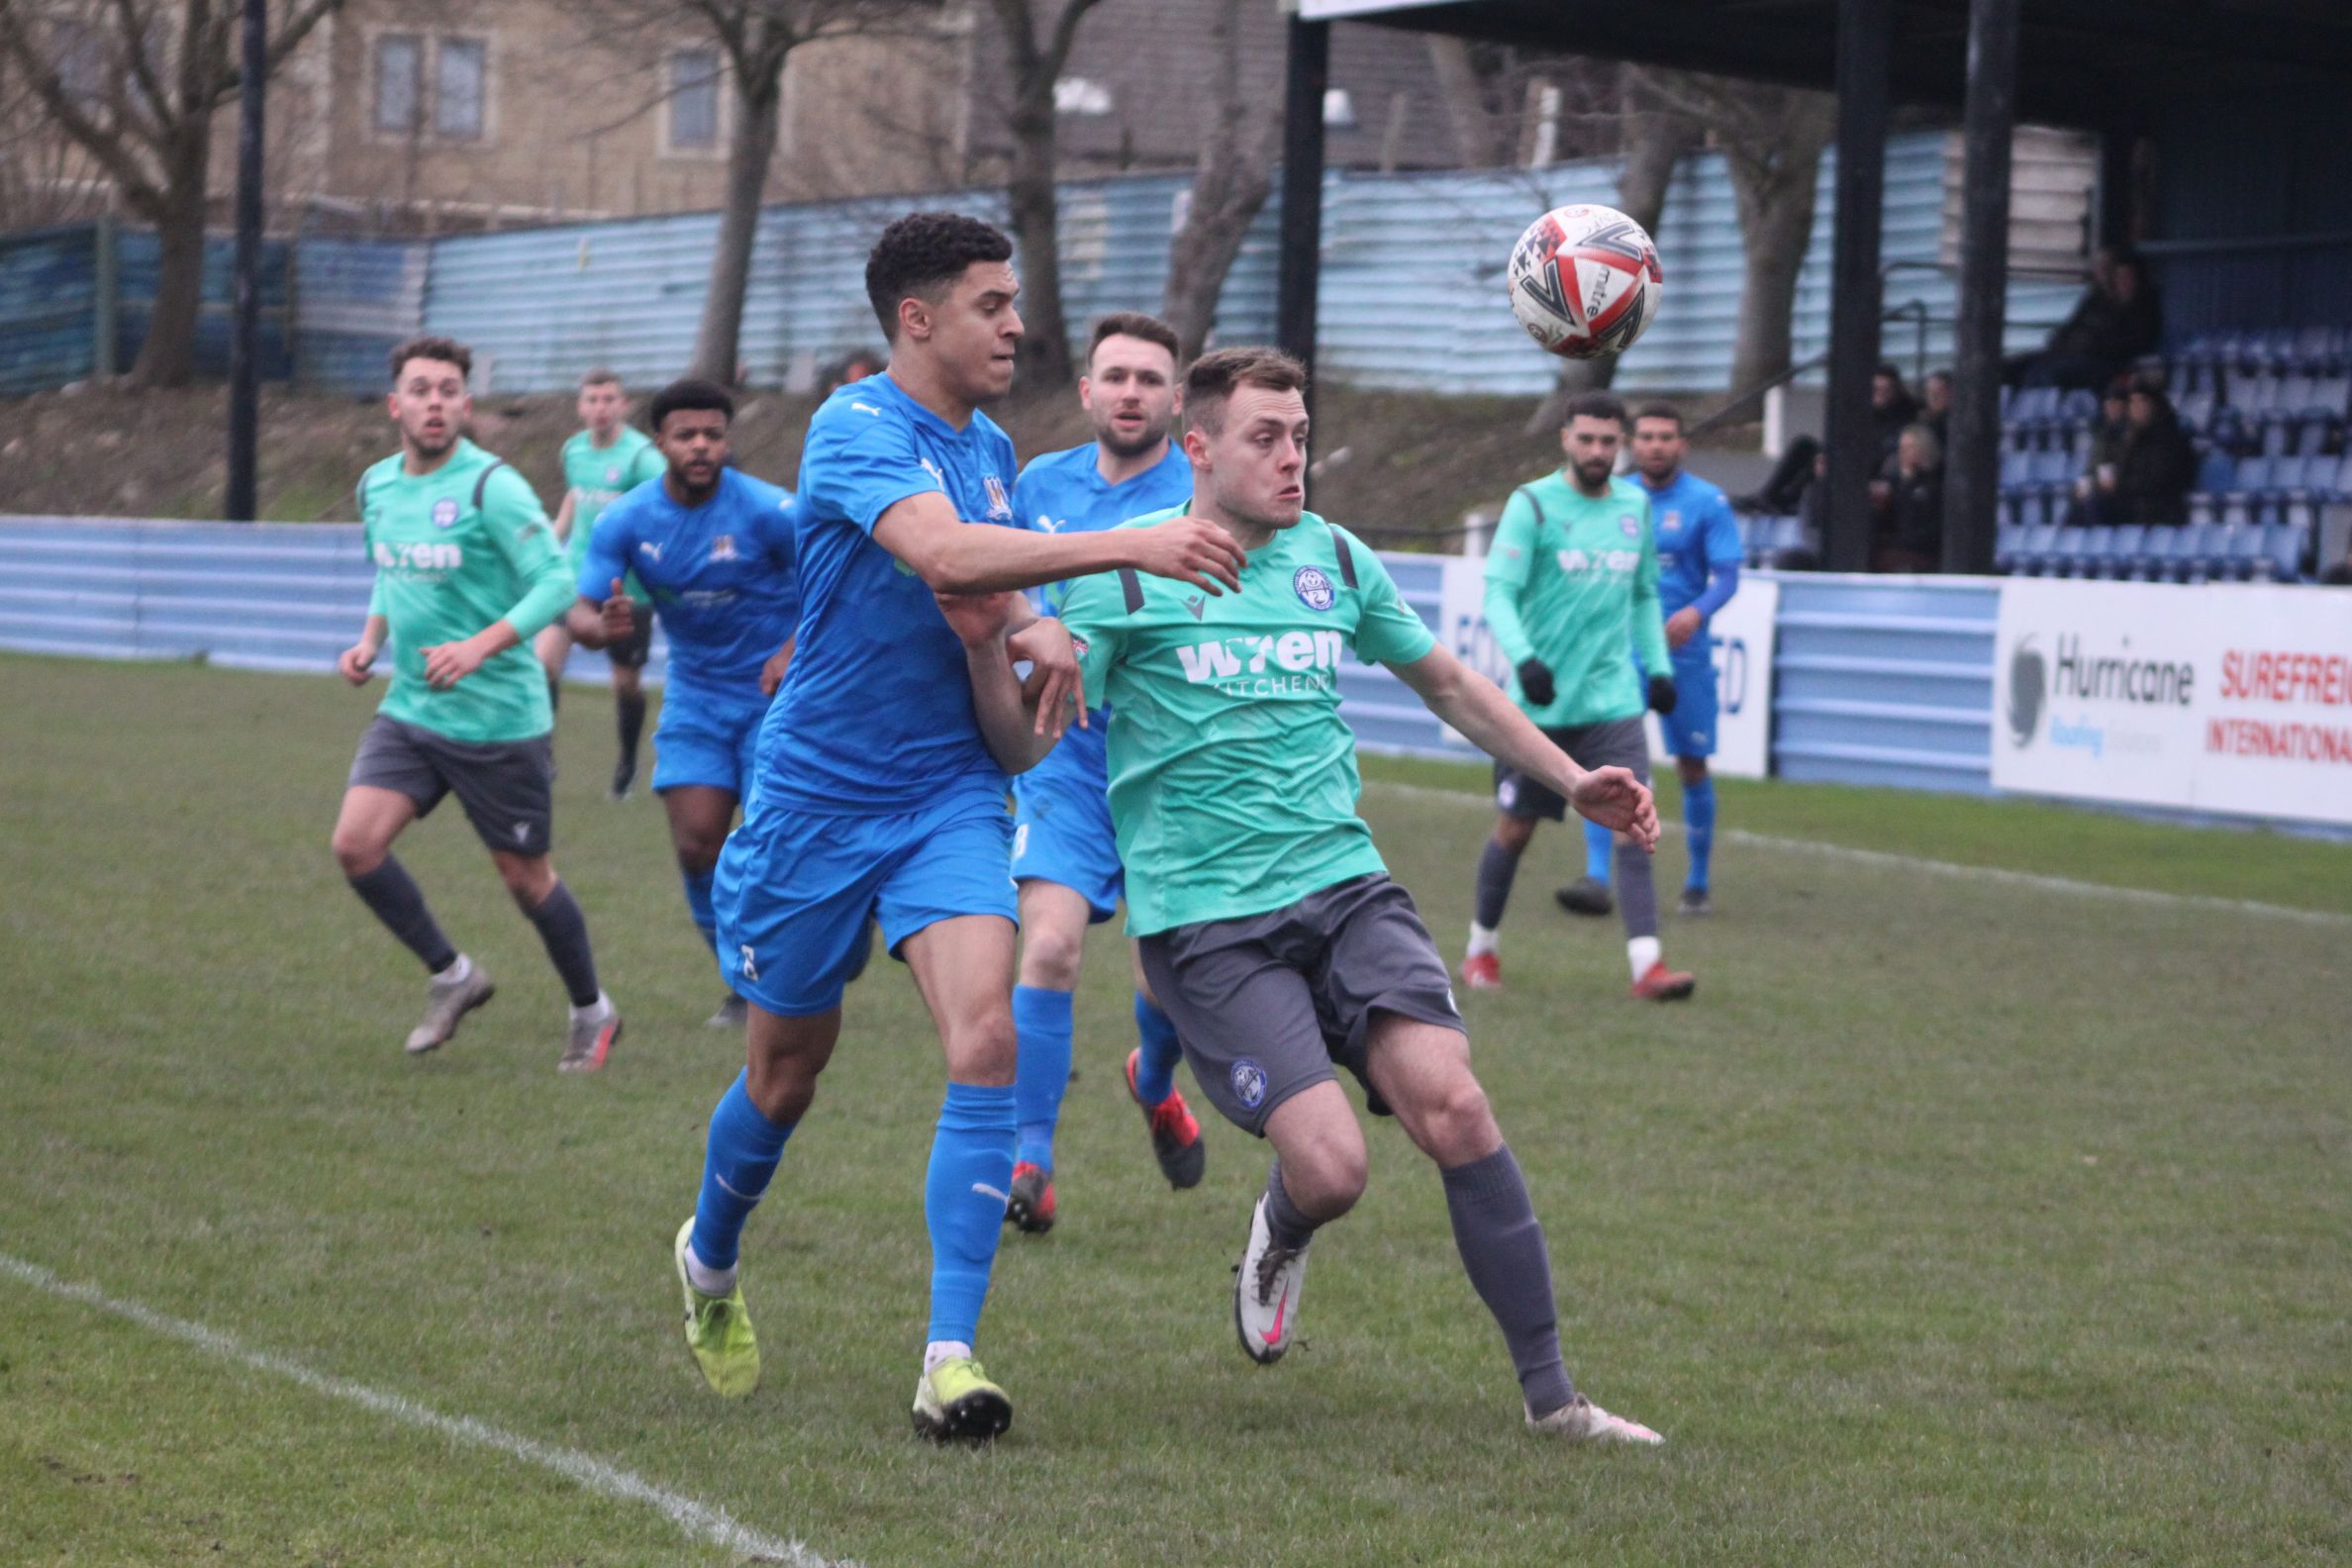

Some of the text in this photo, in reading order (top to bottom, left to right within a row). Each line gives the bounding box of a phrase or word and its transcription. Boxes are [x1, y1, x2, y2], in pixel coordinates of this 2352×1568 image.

[1587, 266, 1611, 317] mitre
[1175, 630, 1342, 683] wren
[2052, 633, 2196, 707] Hurricane
[2219, 650, 2352, 707] SUREFREI
